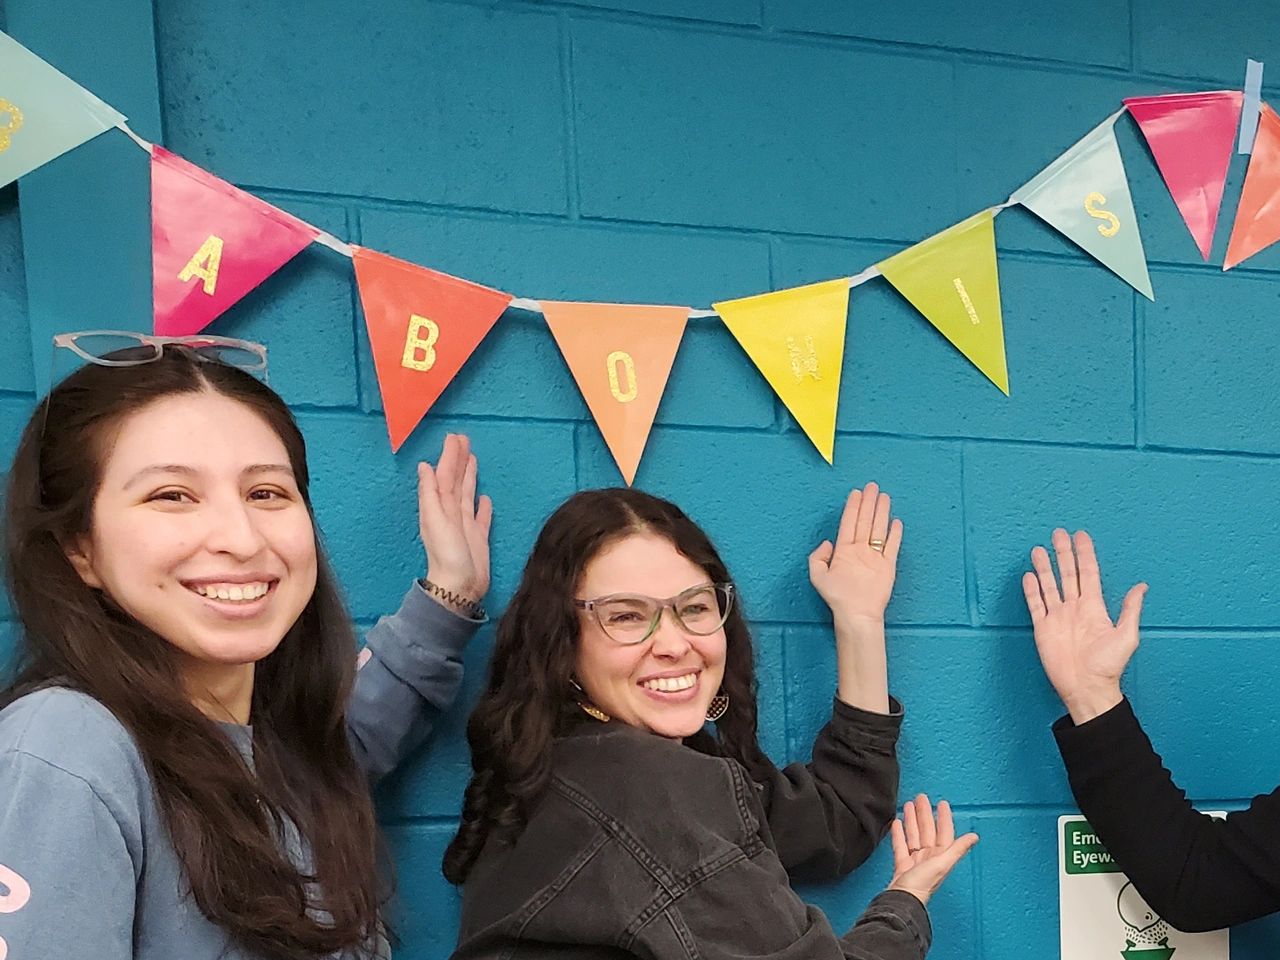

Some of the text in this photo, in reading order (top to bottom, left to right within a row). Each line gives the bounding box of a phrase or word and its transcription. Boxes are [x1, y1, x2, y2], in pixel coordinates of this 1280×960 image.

[176, 234, 225, 296] A
[401, 313, 441, 373] B
[605, 350, 638, 404] O
[1083, 191, 1121, 238] S
